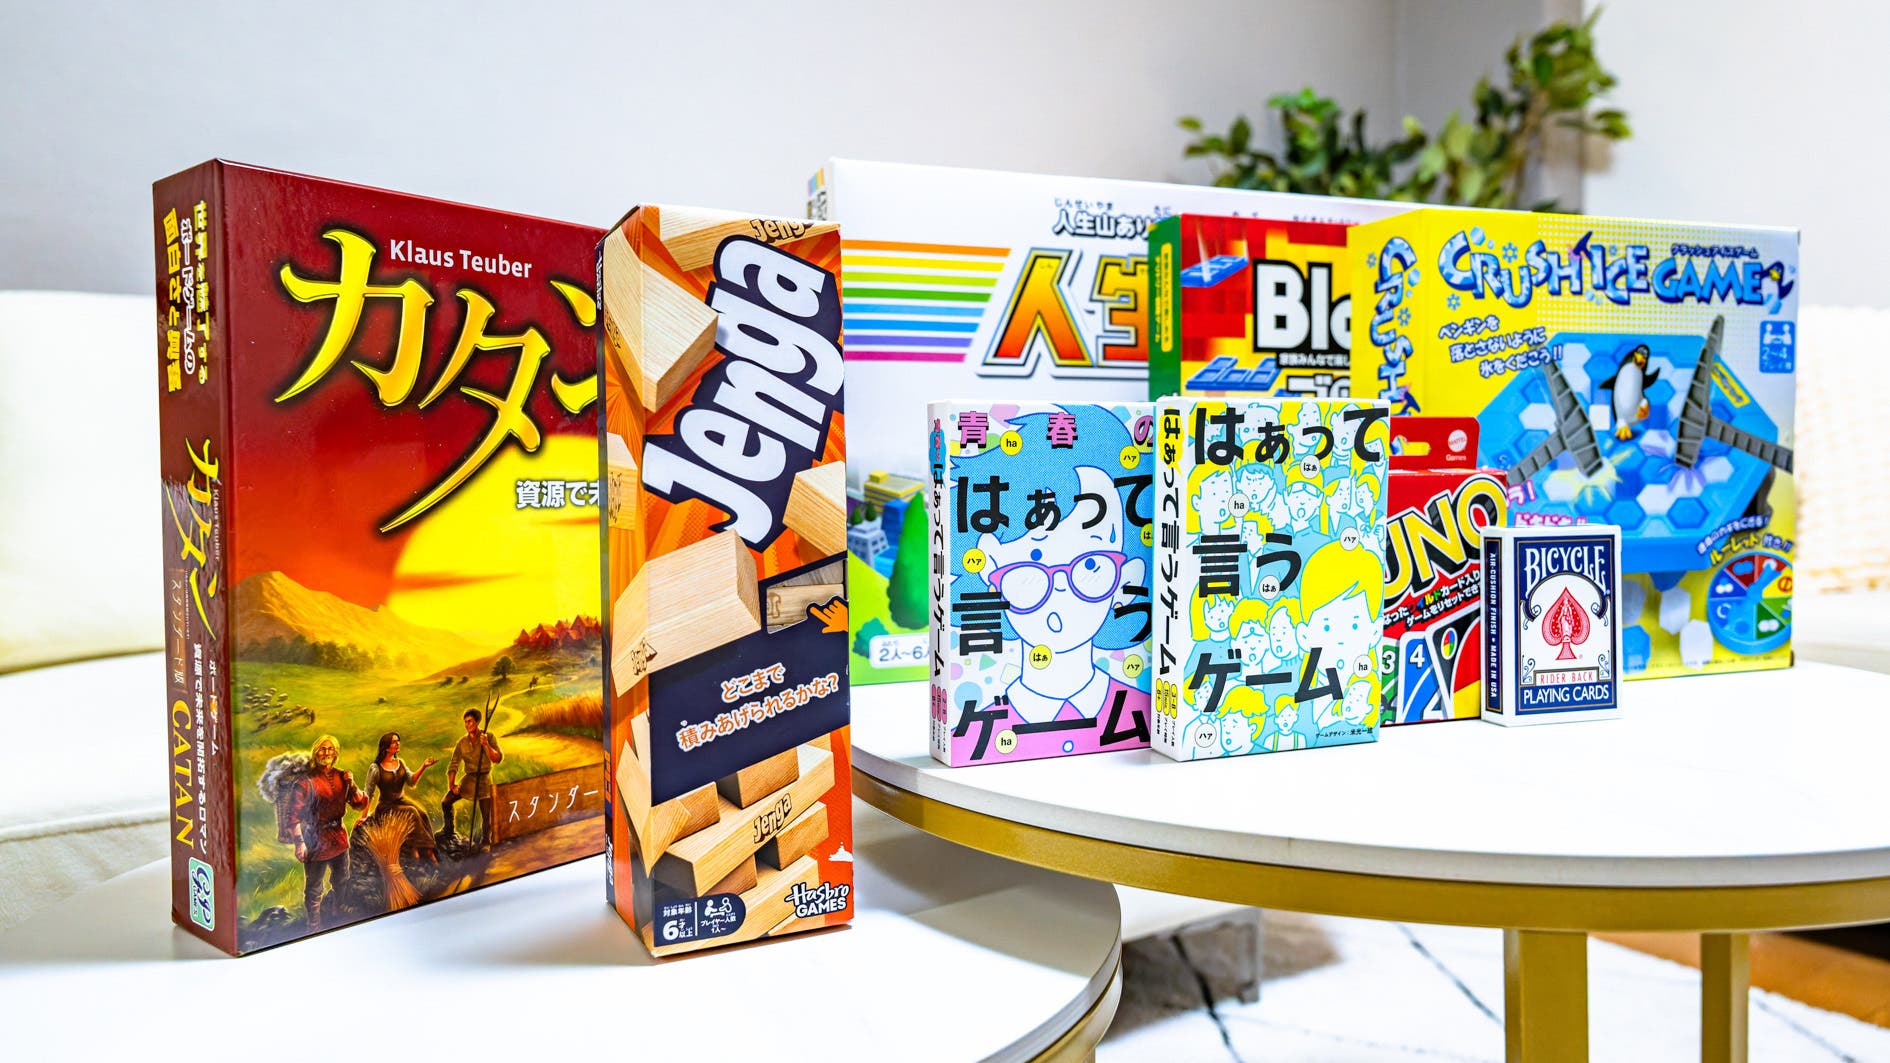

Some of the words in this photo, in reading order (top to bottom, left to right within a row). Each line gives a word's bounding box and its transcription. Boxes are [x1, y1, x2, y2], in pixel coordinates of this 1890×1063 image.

[390, 239, 454, 268] Klaus
[459, 249, 532, 278] Teuber
[1438, 231, 1583, 308] CRUSH
[1590, 244, 1650, 305] ICE
[1652, 257, 1764, 305] GAME
[181, 218, 196, 375] ボードゲームの
[1369, 237, 1418, 403] CRUSH
[1449, 326, 1547, 363] 落とさないように
[642, 238, 844, 545] Jenga
[958, 411, 1153, 449] 青春の
[1006, 438, 1017, 448] ha
[1195, 407, 1389, 465] はぁって
[957, 475, 1152, 533] はぁって
[1234, 501, 1244, 510] ha
[165, 437, 219, 641] カタン
[1160, 408, 1180, 675] はぁって言うゲーム
[1384, 476, 1508, 600] UNO
[1192, 533, 1301, 598] 言う
[1524, 545, 1607, 598] BICYCLE
[1406, 582, 1480, 628] ゲームをリセットでき
[1359, 662, 1368, 672] ha
[1381, 650, 1396, 674] 3
[1409, 644, 1425, 668] 4
[1490, 669, 1497, 679] IN
[1540, 673, 1566, 684] RIDER
[1572, 671, 1593, 682] BACK
[721, 663, 786, 703] どこまで
[1188, 647, 1343, 713] ゲーム
[1524, 686, 1570, 704] PLAYING
[1573, 684, 1609, 701] CARDS
[676, 673, 839, 752] 積みあげられるかな?
[953, 690, 1151, 760] ゲーム
[1001, 737, 1012, 747] ha
[172, 700, 194, 849] CATAN
[508, 785, 598, 823] スタンダー
[754, 793, 792, 843] Jenga
[785, 881, 850, 907] Hasbro
[795, 897, 847, 918] GAMES
[663, 920, 679, 940] 6
